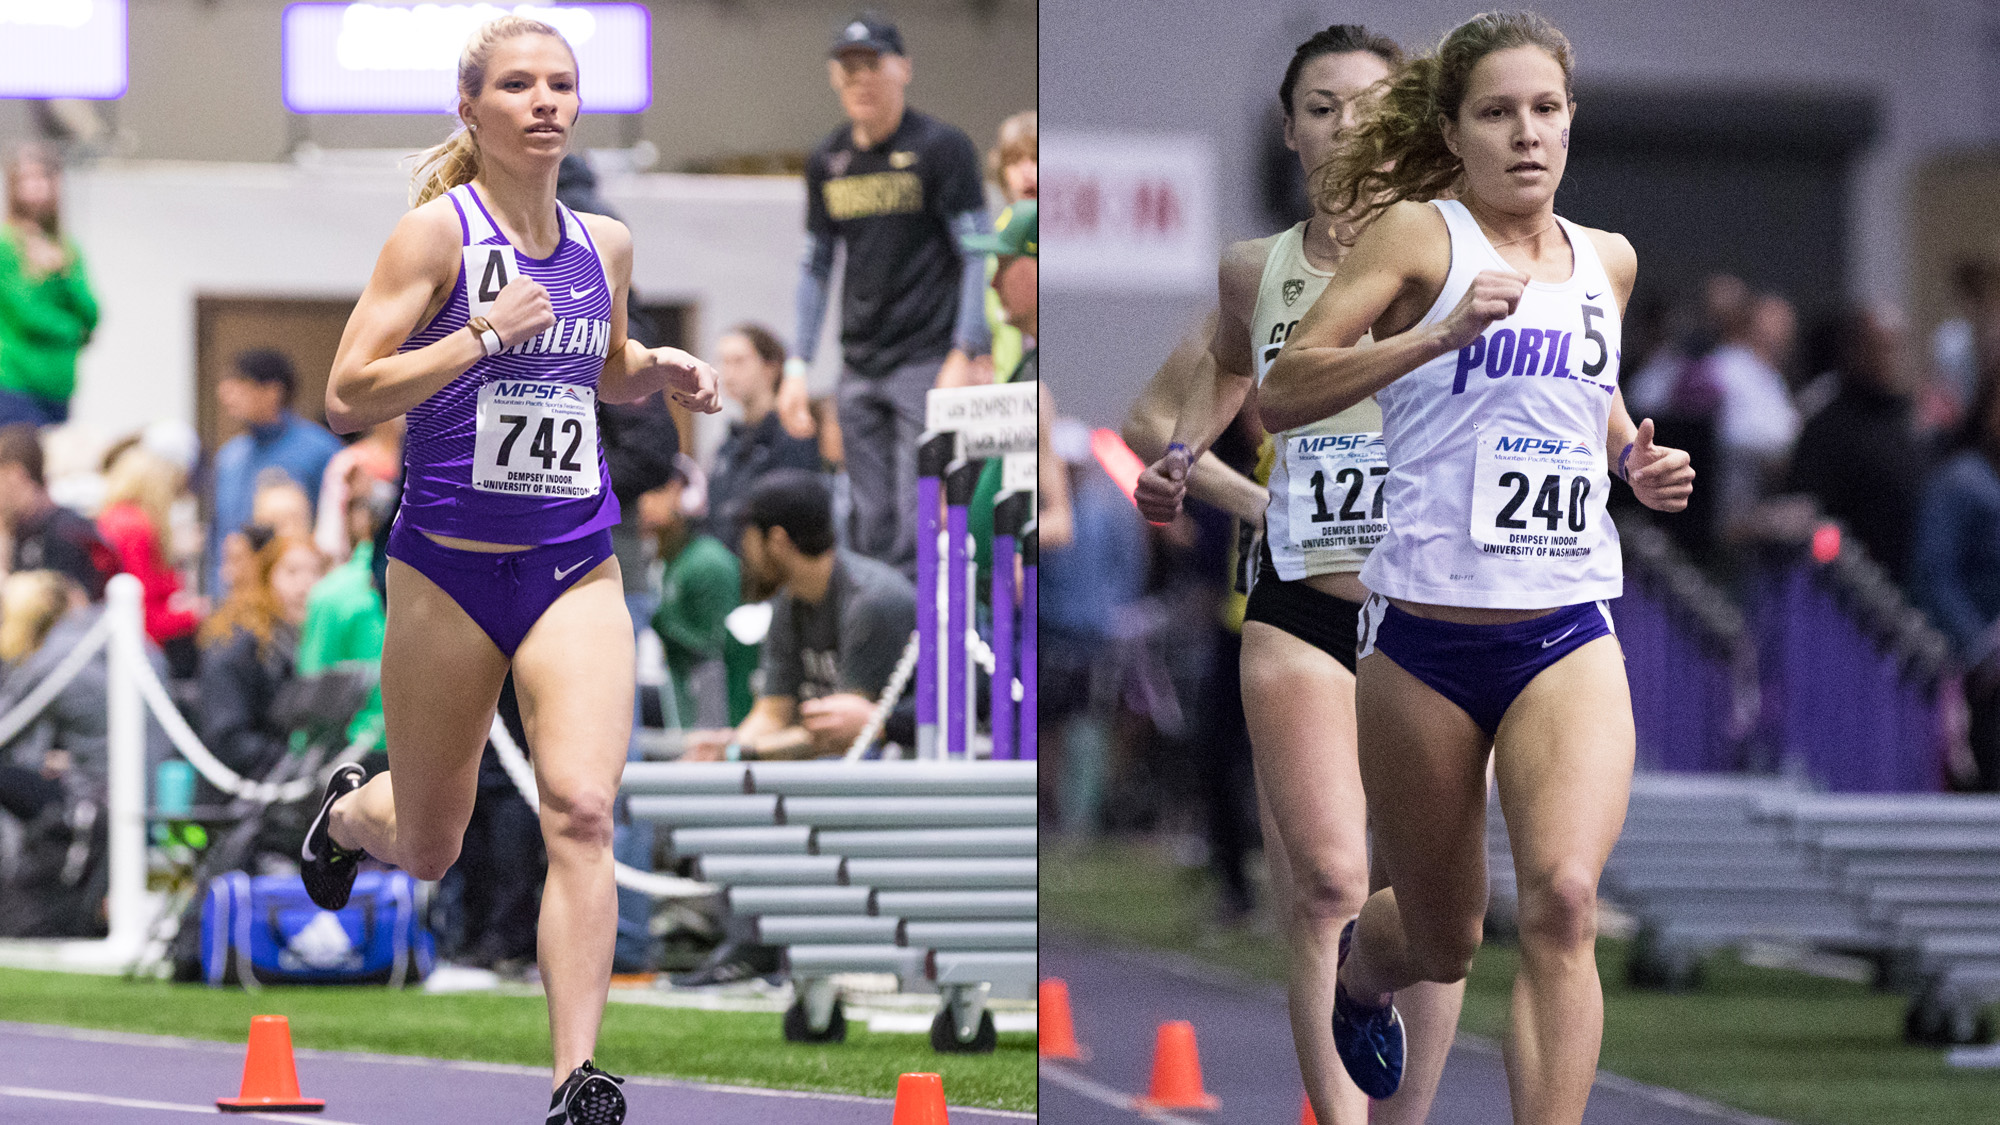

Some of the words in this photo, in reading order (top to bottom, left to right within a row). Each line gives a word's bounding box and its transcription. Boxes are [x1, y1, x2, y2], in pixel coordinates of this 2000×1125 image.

[478, 249, 508, 303] 4
[1581, 303, 1608, 377] 5
[1452, 328, 1620, 396] PORTL
[495, 382, 563, 399] MPSF
[496, 415, 582, 472] 742
[1298, 434, 1367, 453] MPSF
[1495, 436, 1572, 454] MPSF
[1550, 457, 1571, 465] Sports
[507, 471, 545, 483] DEMPSEY
[545, 474, 573, 484] INDOOR
[483, 480, 531, 492] UNIVERSITY
[533, 484, 543, 493] OF
[545, 485, 590, 496] WASHINGTON
[1310, 467, 1390, 523] 127
[1495, 471, 1591, 532] 240
[1322, 525, 1355, 536] DEMPSEY
[1357, 523, 1388, 534] INDOOR
[1301, 536, 1346, 549] UNIVERSITY
[1347, 537, 1357, 546] OF
[1509, 534, 1549, 545] DEMPSEY
[1551, 536, 1578, 545] INDOOR
[1483, 543, 1534, 556] UNIVERSITY
[1536, 547, 1547, 557] OF
[1549, 547, 1591, 557] WASHINGTON
